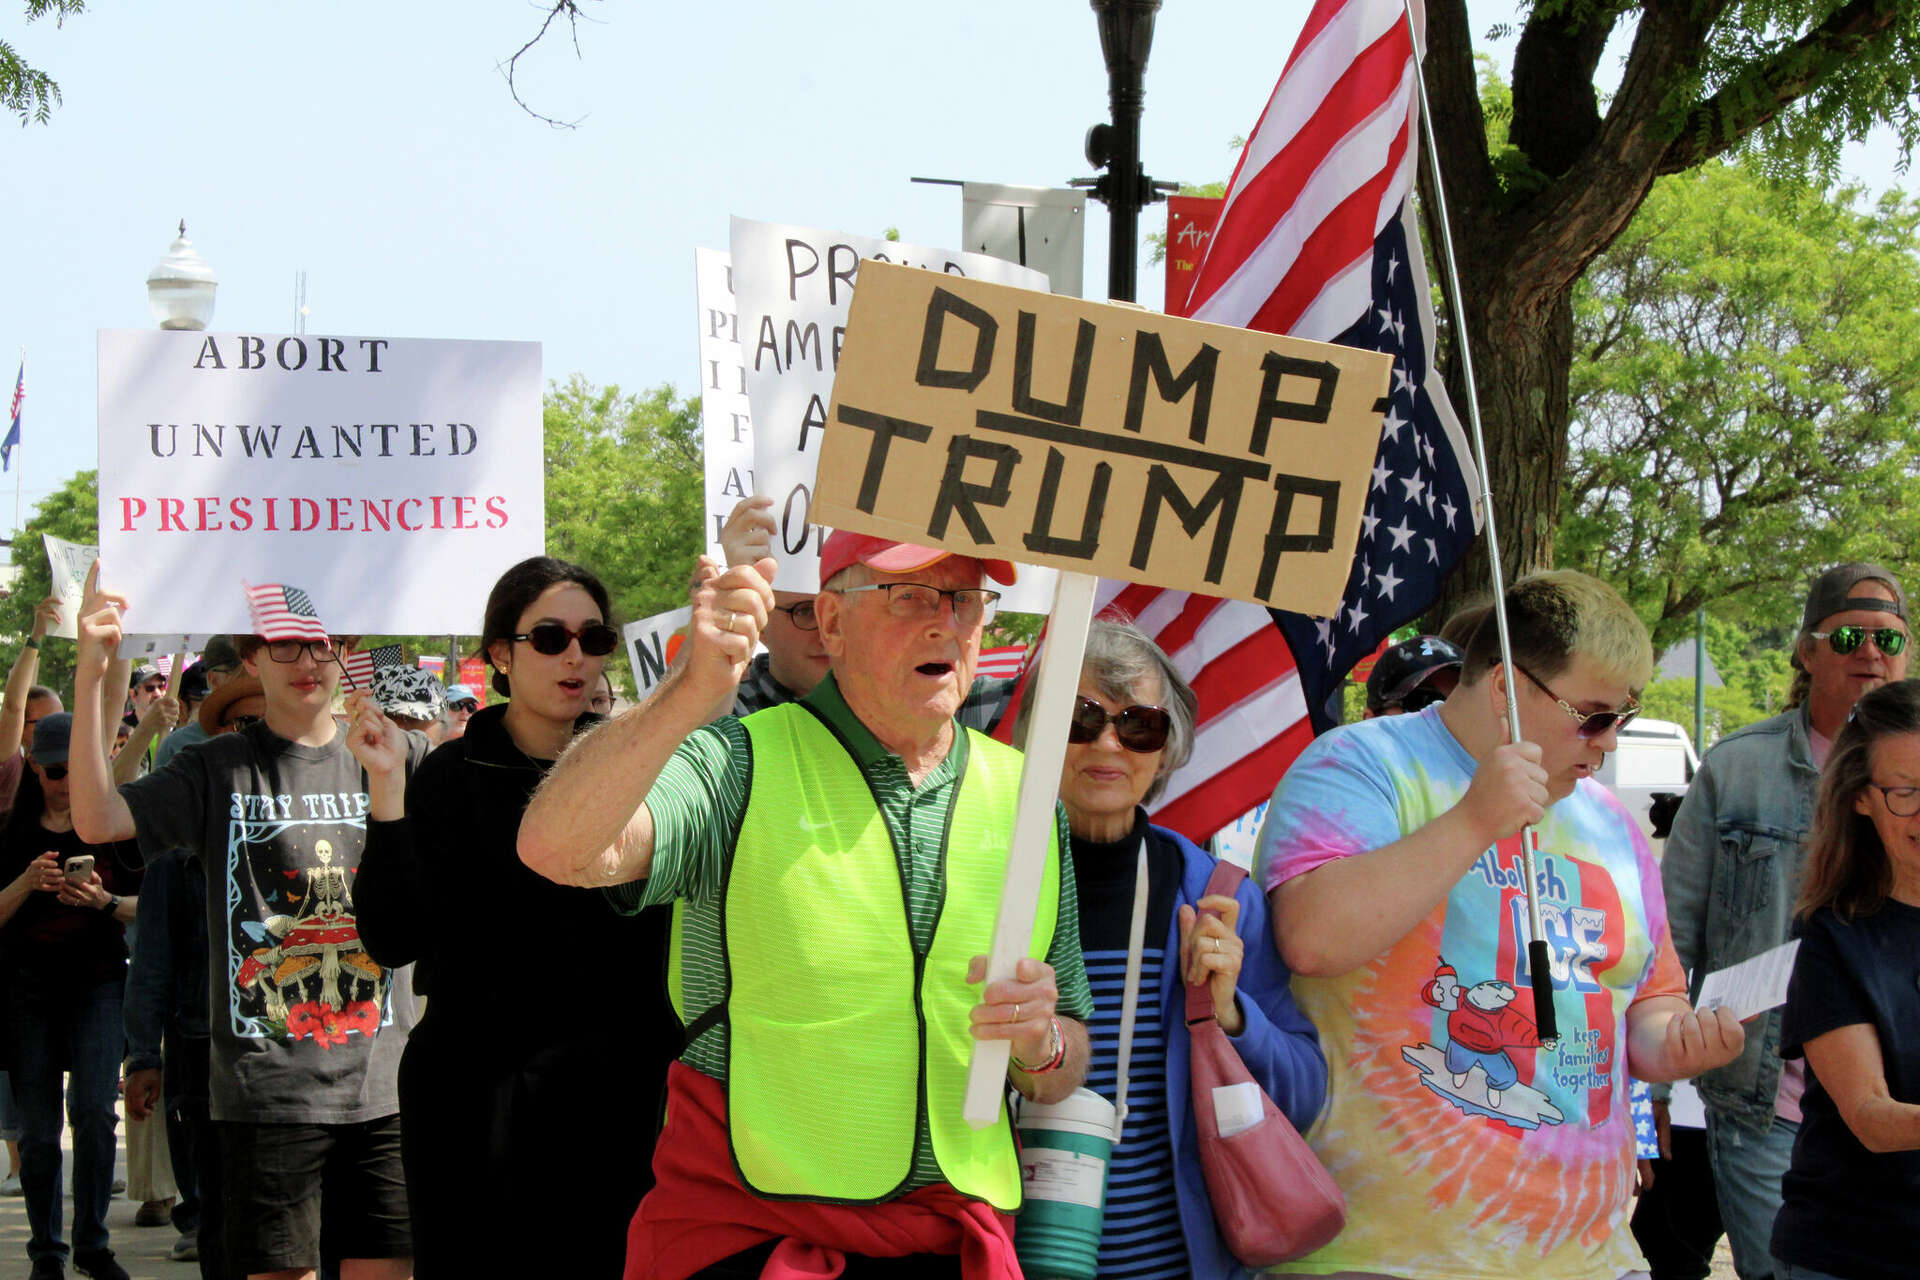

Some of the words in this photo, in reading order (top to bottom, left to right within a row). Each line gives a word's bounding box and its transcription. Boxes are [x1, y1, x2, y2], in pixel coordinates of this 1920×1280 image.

[1177, 221, 1211, 250] Ar
[193, 335, 389, 373] ABORT
[915, 286, 1340, 457] DUMP
[146, 423, 479, 459] UNWANTED
[119, 496, 510, 532] PRESIDENCIES
[837, 404, 1341, 602] TRUMP
[230, 792, 292, 820] STAY
[302, 792, 371, 819] TRIP
[1470, 849, 1567, 900] Abolsh
[1510, 895, 1607, 992] ICE
[1558, 1042, 1609, 1067] families
[1573, 1026, 1600, 1047] keep
[1553, 1066, 1609, 1094] together
